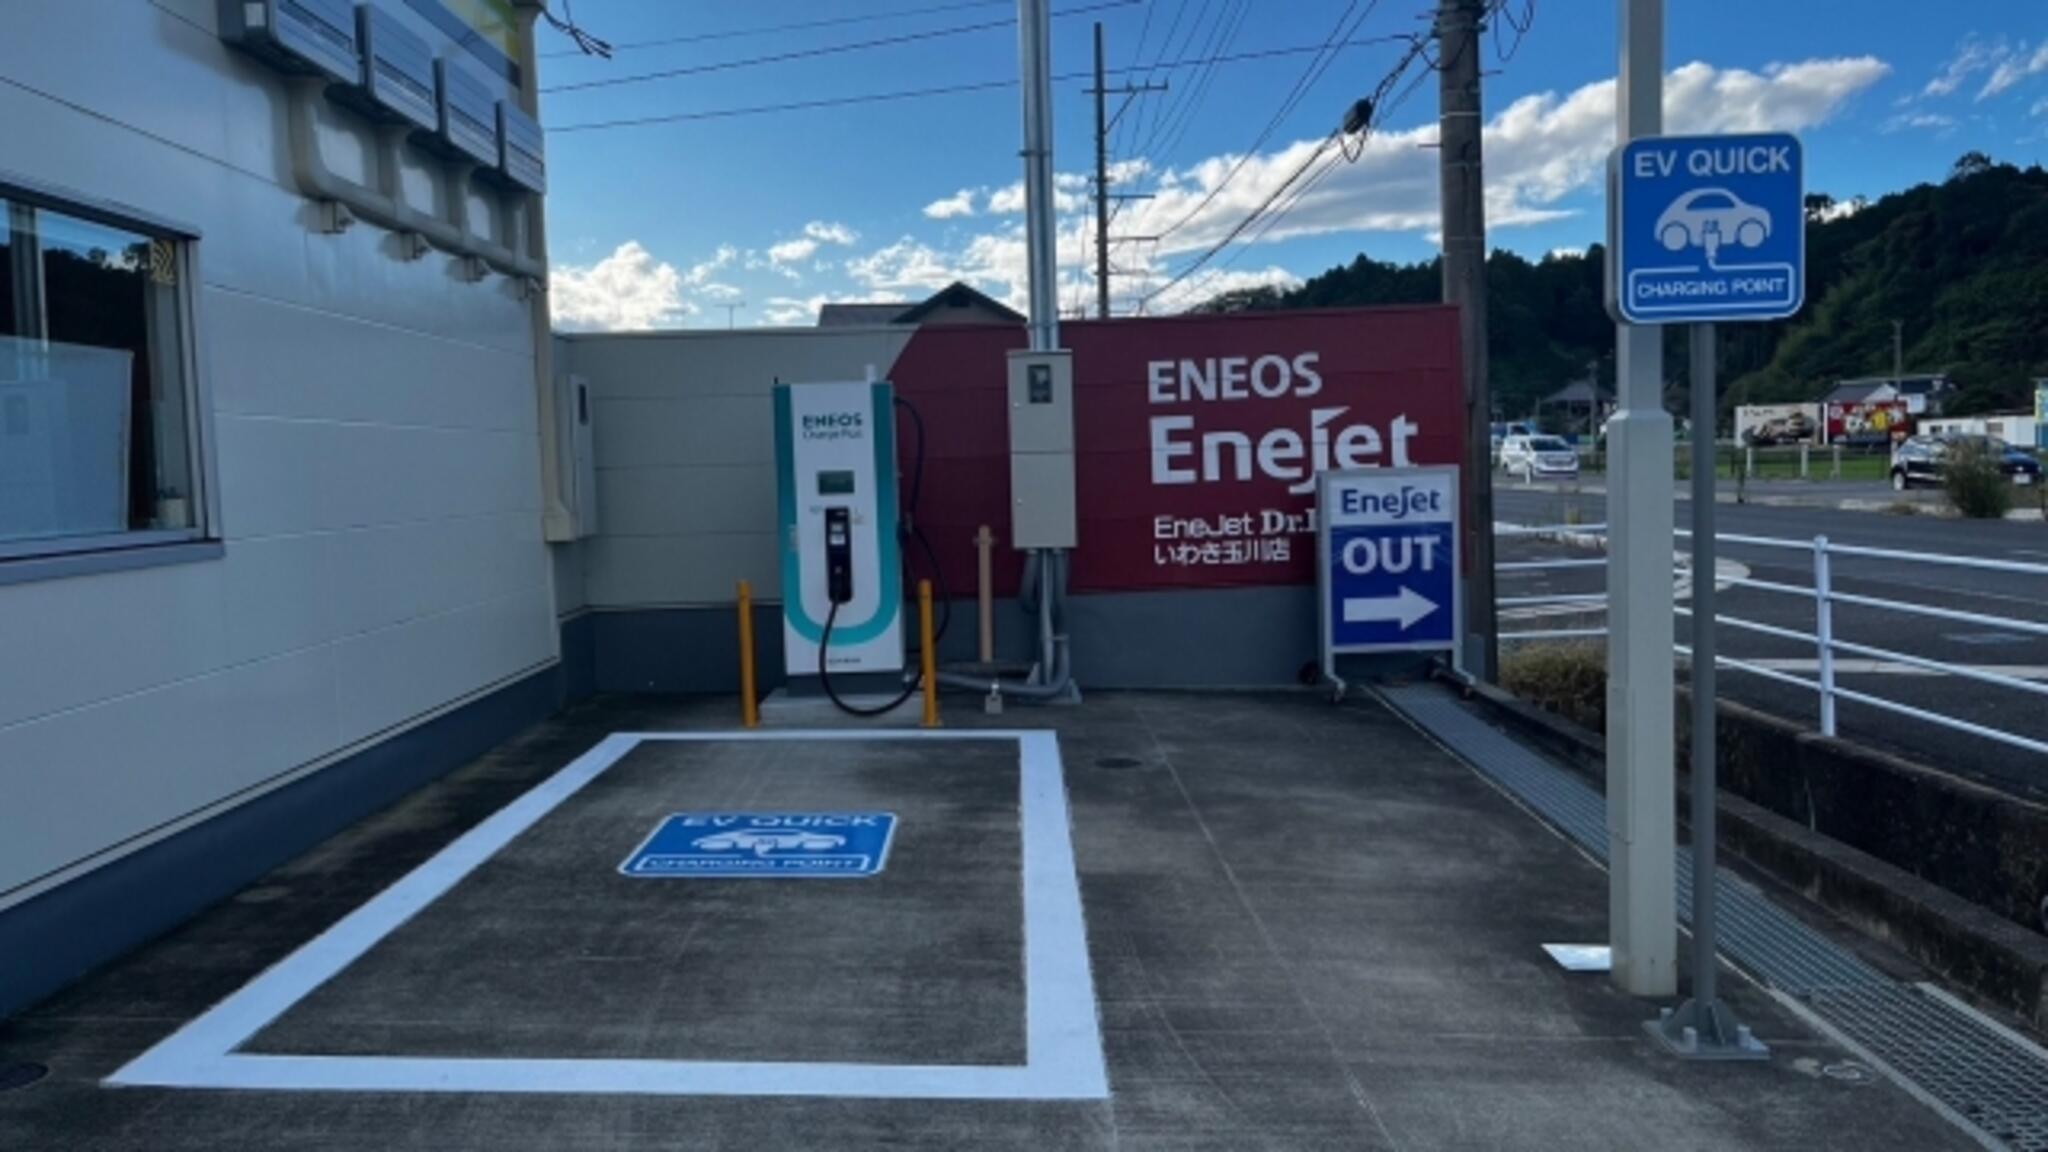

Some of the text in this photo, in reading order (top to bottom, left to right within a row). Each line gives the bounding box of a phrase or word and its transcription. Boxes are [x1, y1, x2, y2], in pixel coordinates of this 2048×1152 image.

[1634, 146, 1791, 177] EV QUICK
[1637, 277, 1786, 299] CHARGING POINT
[1148, 352, 1323, 403] ENEOS
[802, 412, 863, 429] ENEOS
[1154, 538, 1290, 565] いわき玉川店
[1342, 535, 1441, 574] OUT
[681, 814, 877, 827] EV QUICK
